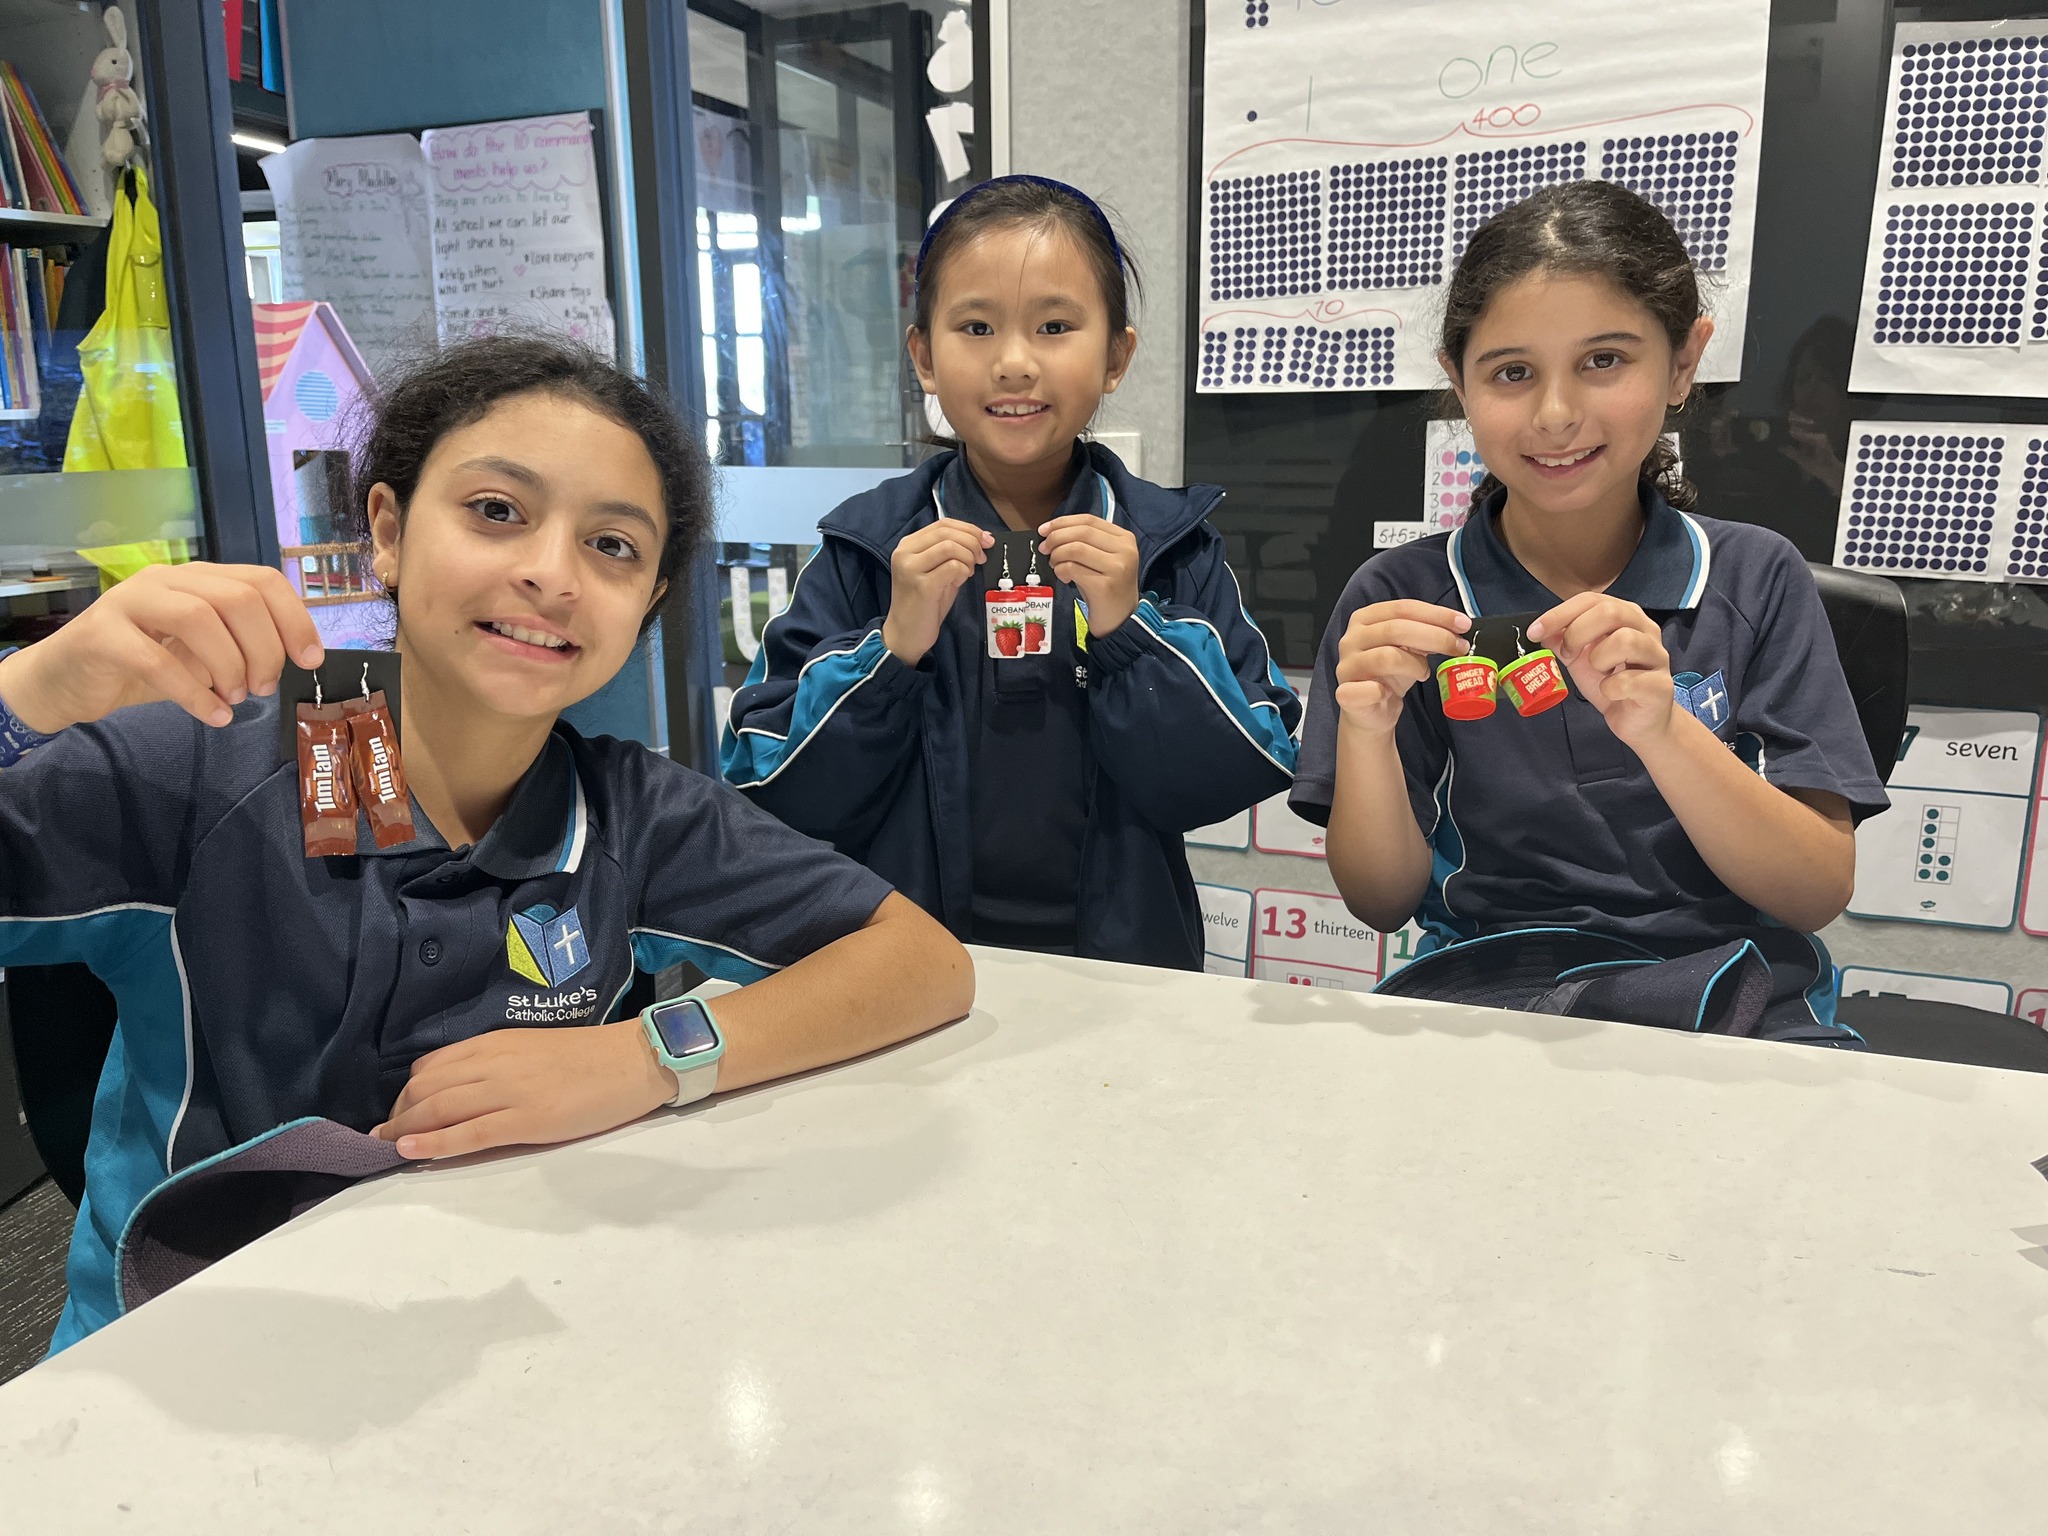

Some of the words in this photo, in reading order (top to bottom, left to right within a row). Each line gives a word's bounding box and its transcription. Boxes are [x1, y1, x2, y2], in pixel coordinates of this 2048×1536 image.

[1439, 42, 1562, 98] one
[1472, 103, 1541, 130] 400
[532, 209, 548, 227] let
[1432, 471, 1441, 486] 2
[1429, 492, 1440, 509] 3
[1429, 511, 1440, 527] 4
[991, 606, 1026, 614] CHOBANI
[1025, 601, 1051, 609] OBANI
[1455, 667, 1485, 681] GINGER
[1520, 662, 1548, 685] GINGER
[1456, 676, 1484, 692] BREAD
[1525, 672, 1551, 694] BREAD
[1946, 741, 2018, 761] seven
[1202, 911, 1239, 928] welve
[1261, 906, 1307, 939] 13
[1314, 920, 1375, 942] thirteen
[508, 994, 530, 1007] St
[534, 986, 597, 1008] Luke's
[505, 1008, 555, 1022] Catholic
[556, 1005, 596, 1021] College
